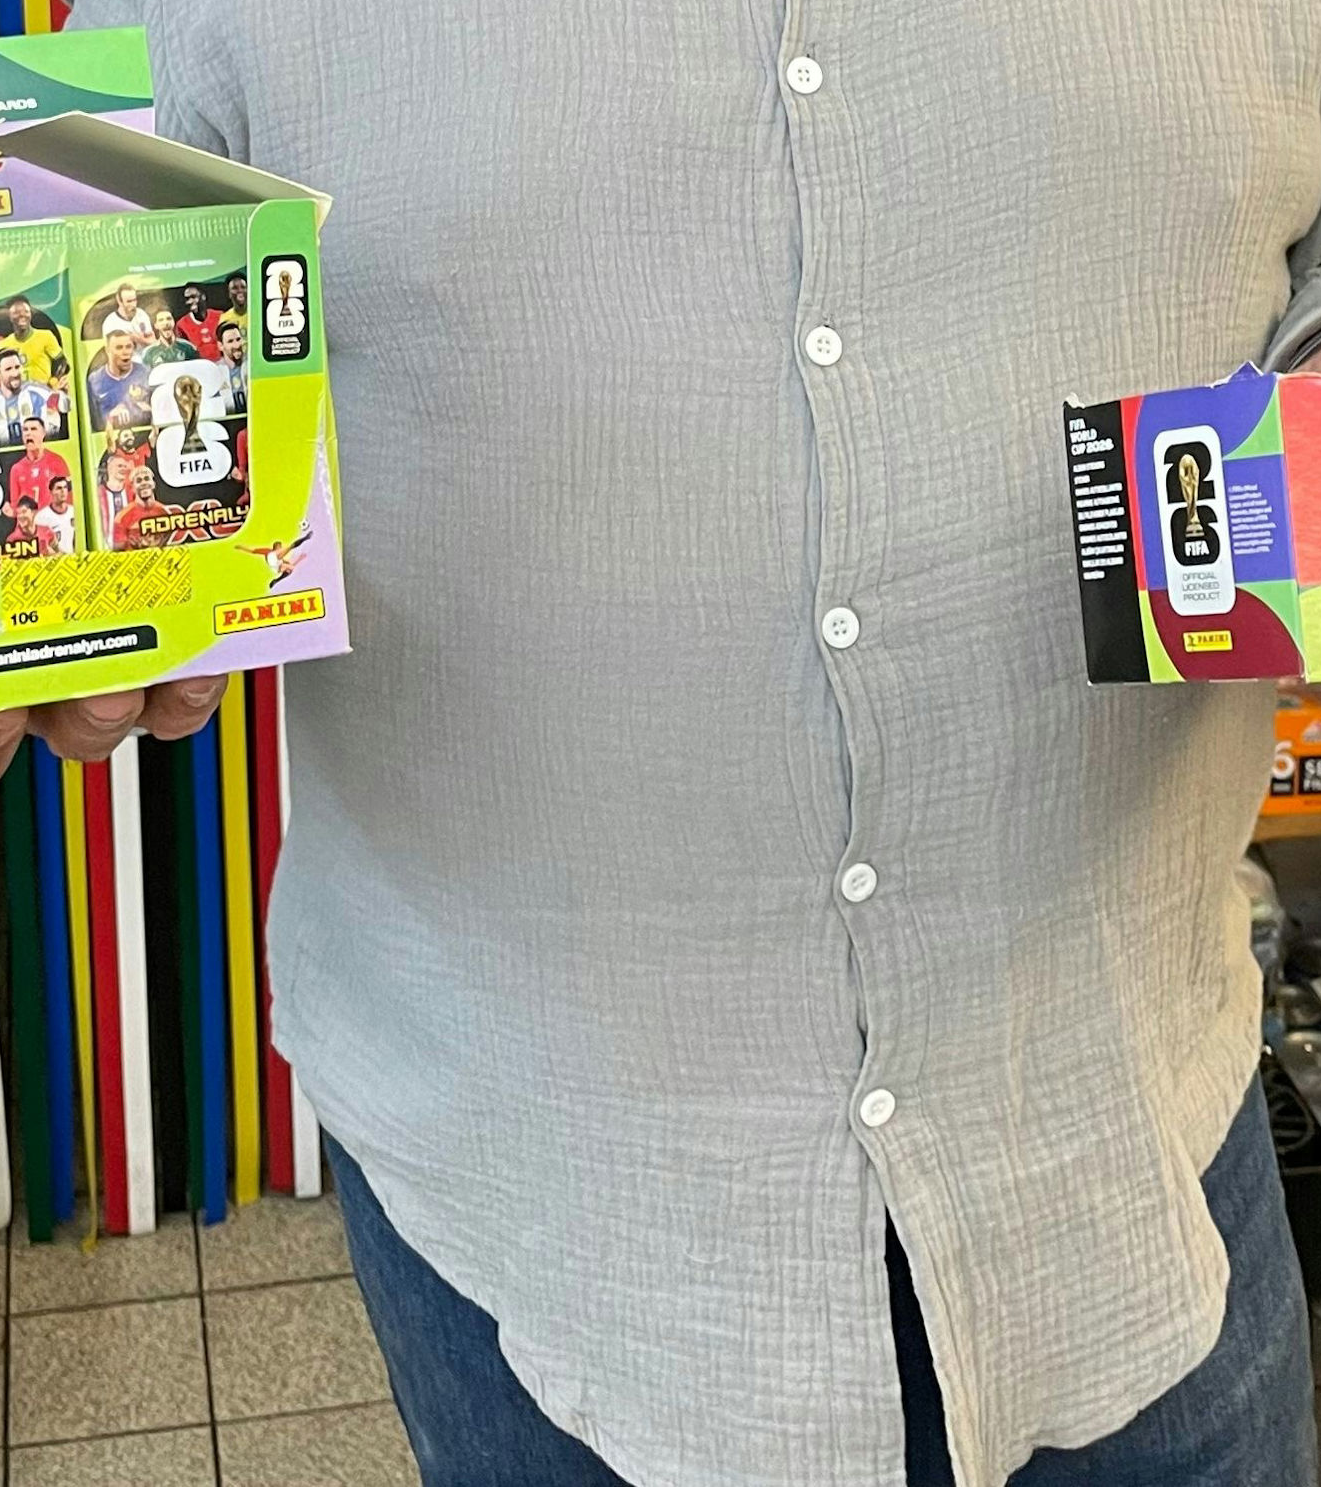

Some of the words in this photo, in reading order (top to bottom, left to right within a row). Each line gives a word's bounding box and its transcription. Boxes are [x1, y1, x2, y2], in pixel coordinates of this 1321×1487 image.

[180, 460, 212, 474] FIFA
[11, 611, 39, 625] 106
[224, 598, 318, 626] PANINI
